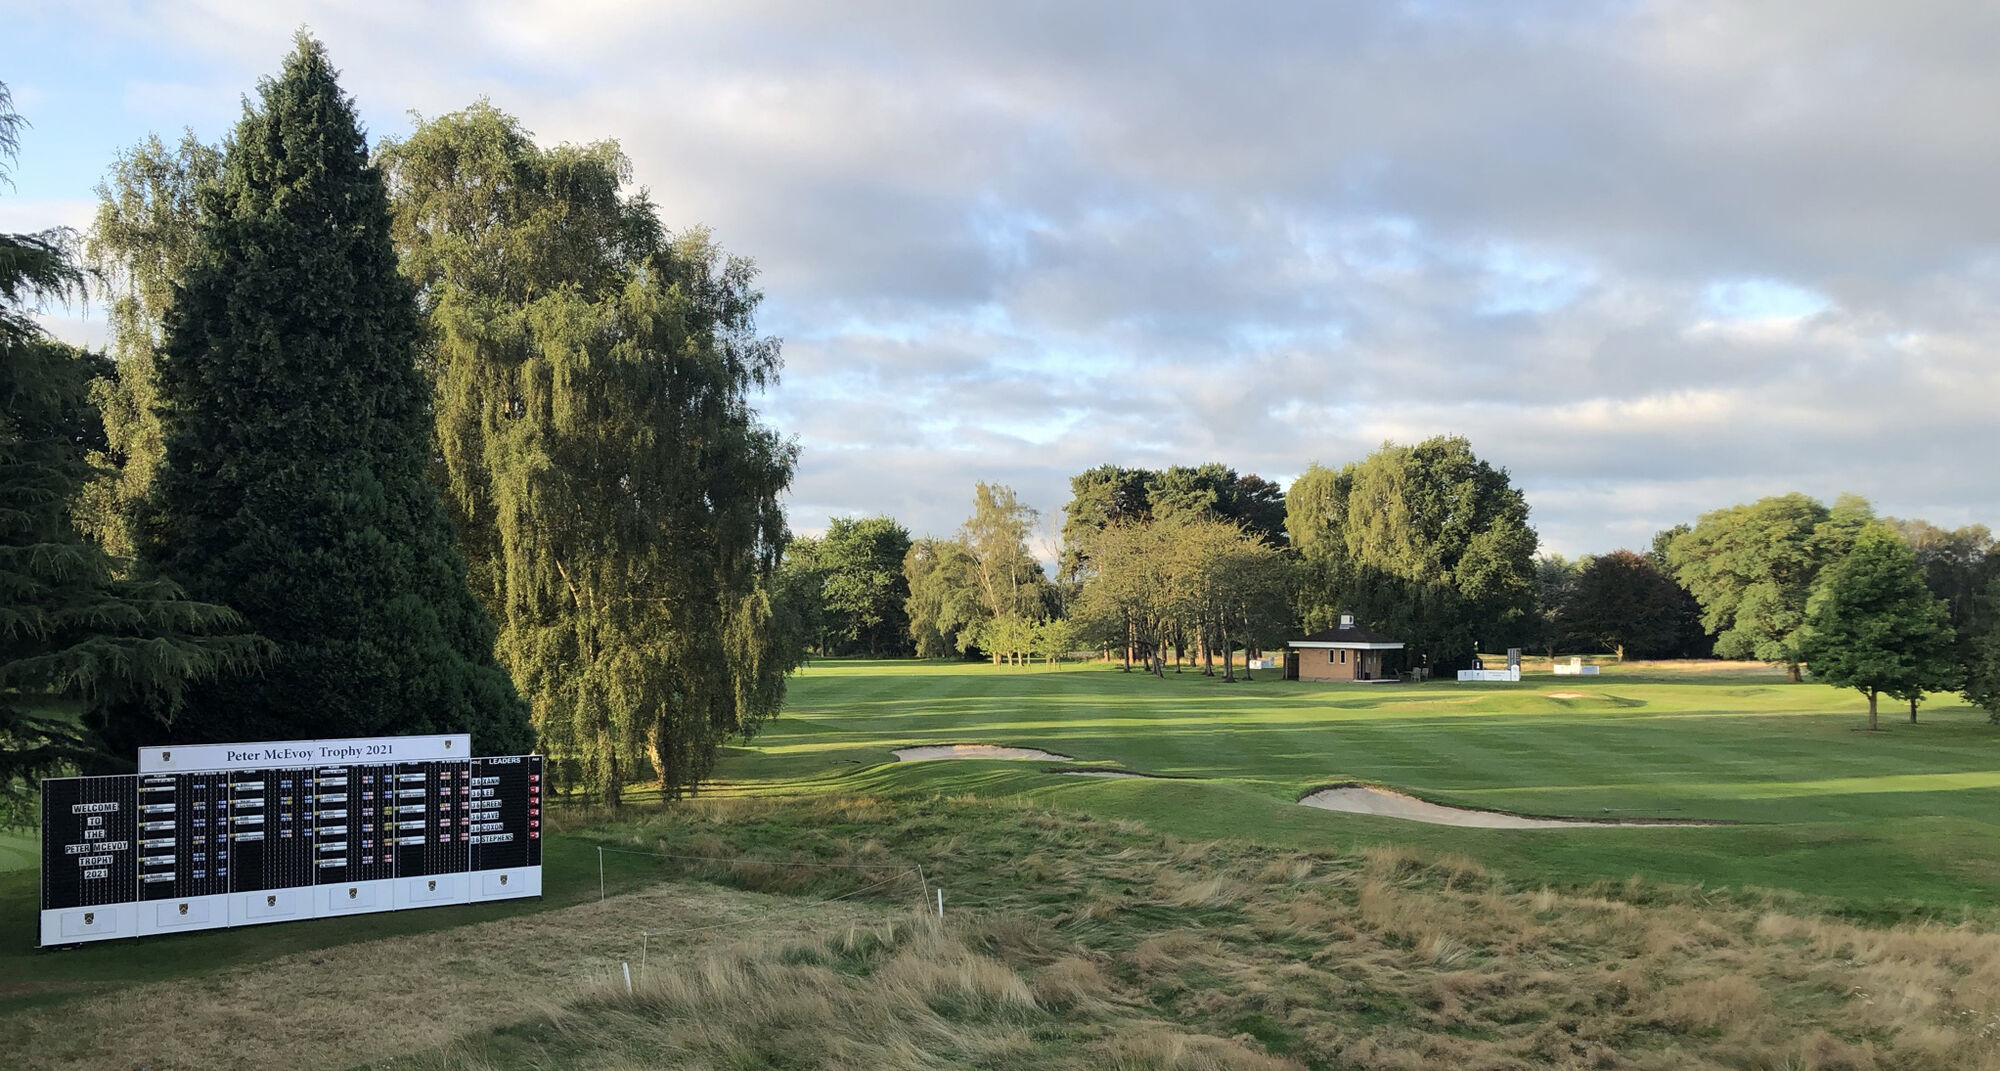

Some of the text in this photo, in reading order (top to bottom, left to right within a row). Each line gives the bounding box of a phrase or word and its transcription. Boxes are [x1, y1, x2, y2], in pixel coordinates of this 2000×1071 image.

[227, 744, 393, 762] Peter McEvoy Trophy 2021
[73, 803, 118, 813] WELCOME
[89, 817, 101, 825] TO
[481, 833, 513, 843] STEPHENS
[66, 842, 127, 853] PETER MCEVOY
[79, 856, 112, 865] TROPHY
[86, 870, 107, 878] 2021
